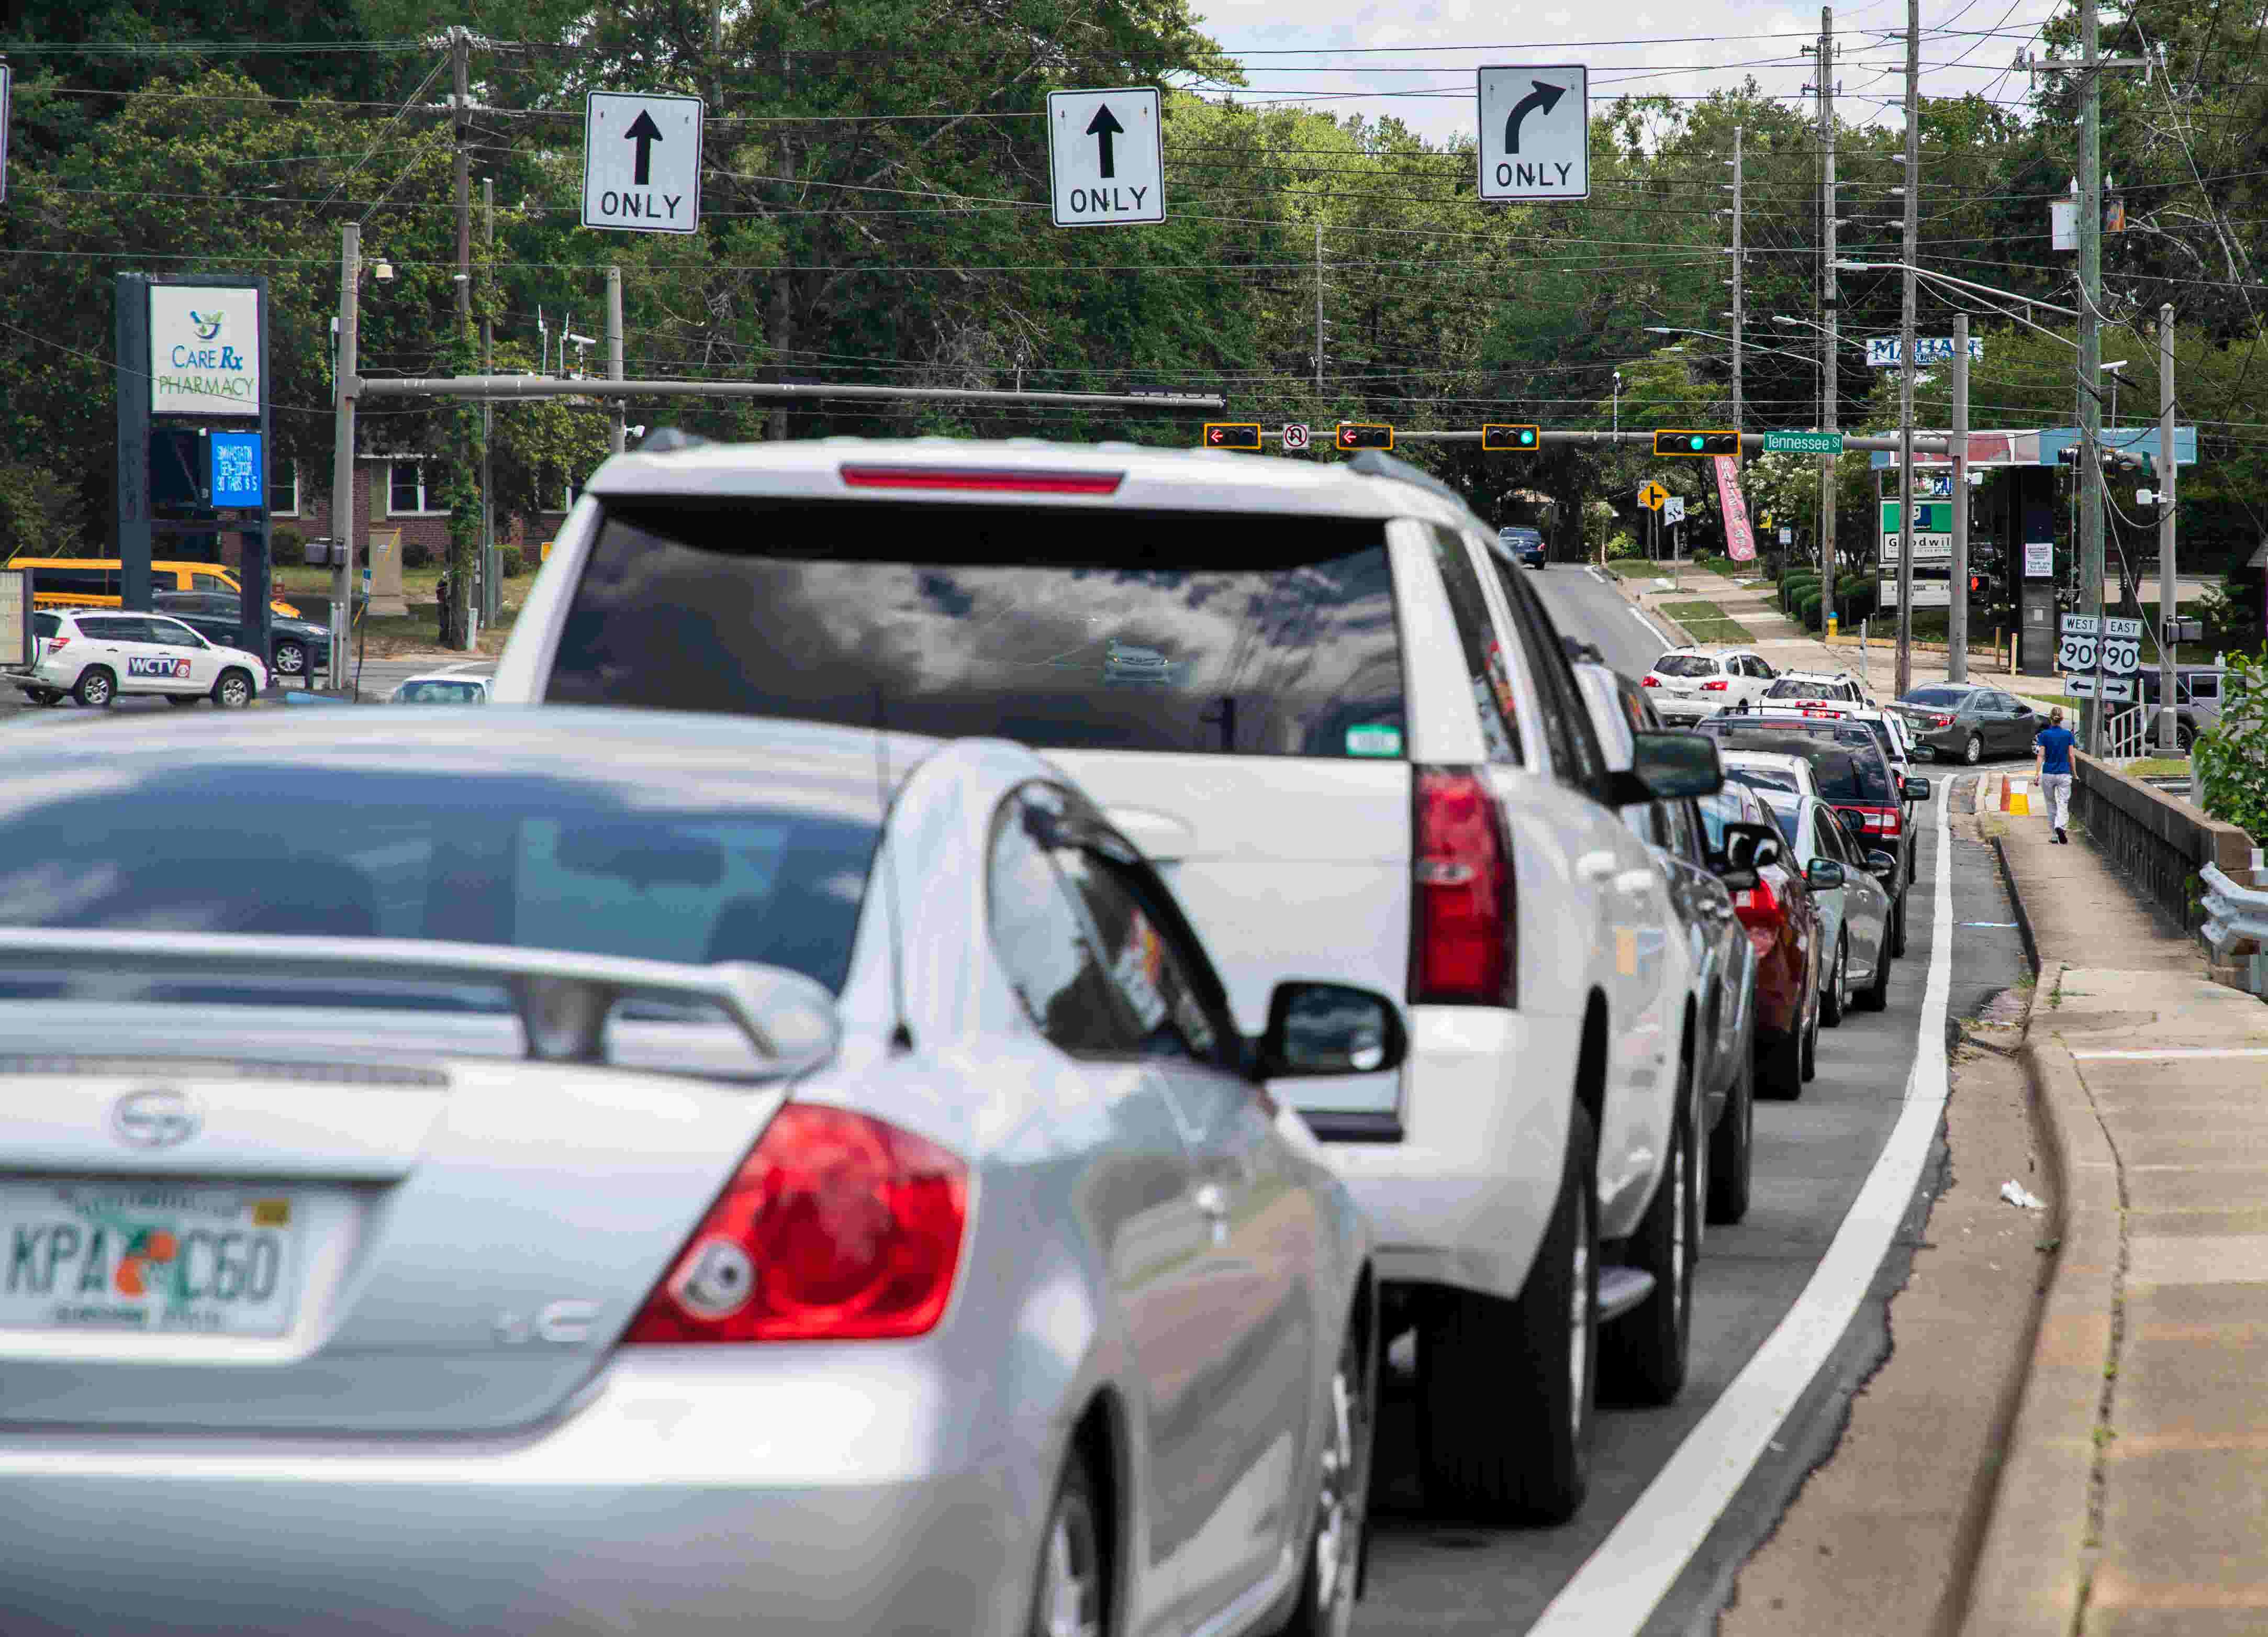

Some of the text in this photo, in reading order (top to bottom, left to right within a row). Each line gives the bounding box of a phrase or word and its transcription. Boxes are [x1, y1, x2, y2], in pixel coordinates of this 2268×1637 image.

[1496, 162, 1572, 187] ONLY
[601, 191, 682, 219] ONLY
[1070, 186, 1148, 214] ONLY
[159, 376, 255, 395] PHARMACY
[1767, 435, 1840, 450] Tennessee St
[2066, 618, 2094, 630] WEST
[2110, 621, 2137, 633] EAST
[2065, 642, 2092, 664] 90
[2107, 647, 2136, 669] 90
[130, 658, 178, 674] WCTV
[5, 1221, 108, 1296] KPA
